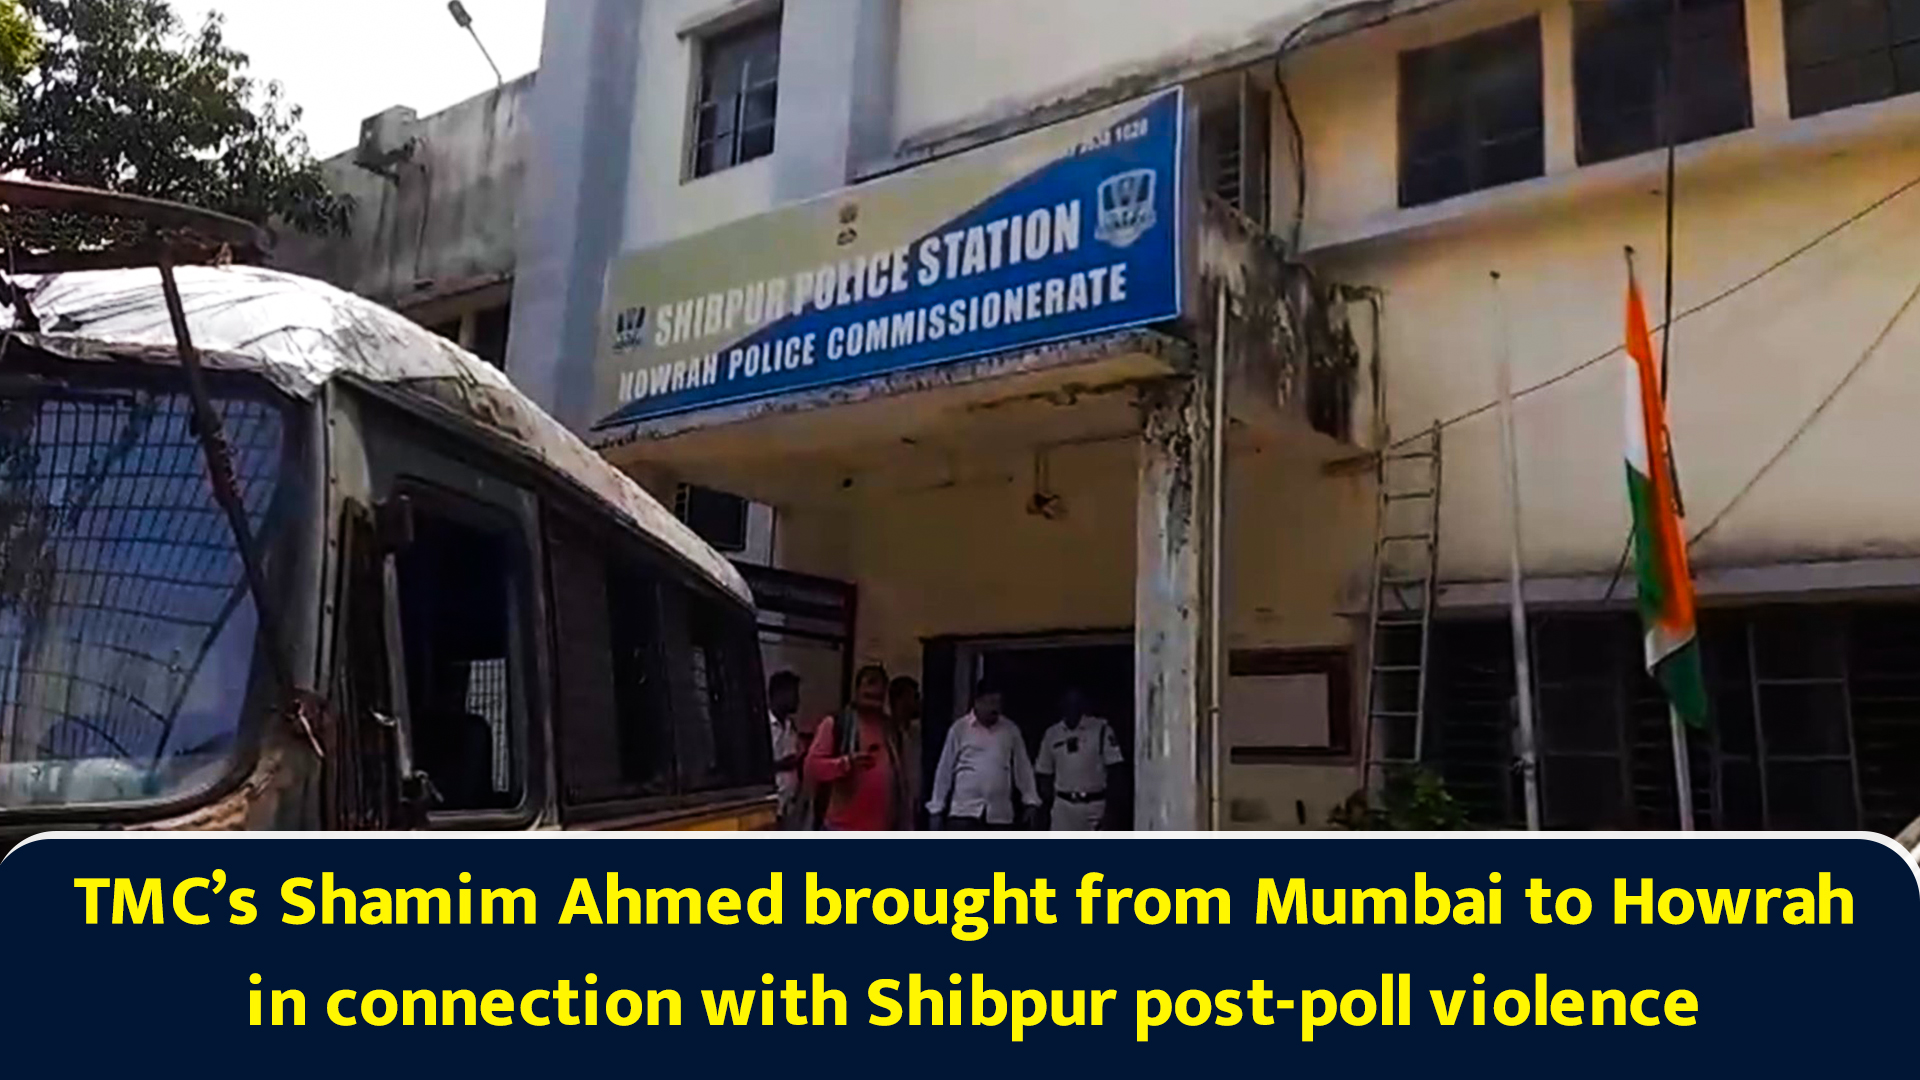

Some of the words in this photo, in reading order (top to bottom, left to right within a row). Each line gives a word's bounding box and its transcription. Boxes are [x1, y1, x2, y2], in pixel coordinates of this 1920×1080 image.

[618, 353, 719, 402] HOWRAH
[727, 332, 816, 381] POLICE
[826, 262, 1127, 361] COMMISSIONERATE
[654, 277, 792, 348] SHIBPUR
[791, 243, 911, 316] POLICE
[917, 199, 1081, 287] STATION
